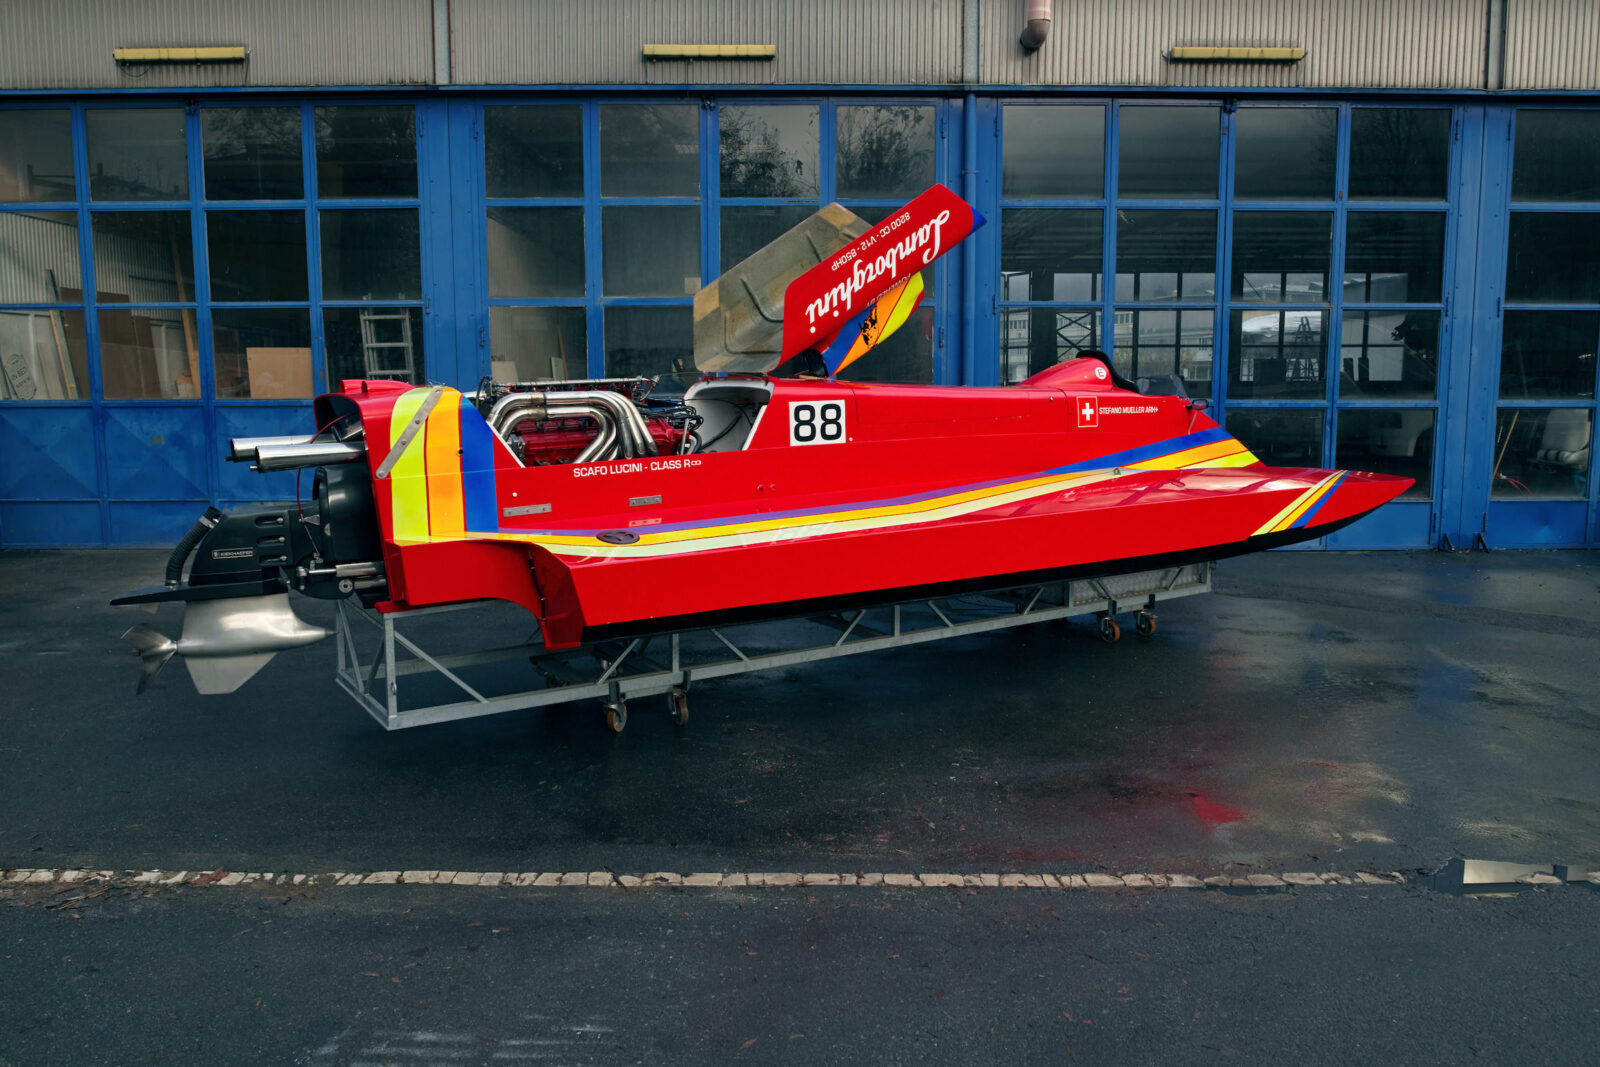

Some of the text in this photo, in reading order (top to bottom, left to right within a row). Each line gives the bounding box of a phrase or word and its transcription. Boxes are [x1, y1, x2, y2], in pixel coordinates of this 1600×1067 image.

[891, 212, 911, 230] 8200
[879, 225, 891, 238] CC
[860, 236, 877, 251] V12
[831, 248, 857, 271] 850HP
[805, 209, 950, 334] Lamborghini
[1099, 407, 1121, 415] STEFANO
[1122, 406, 1145, 414] MUELLER
[793, 403, 842, 442] 88
[573, 465, 608, 478] SCAFO
[609, 463, 643, 475] LUCINI
[650, 459, 682, 471] CLASS
